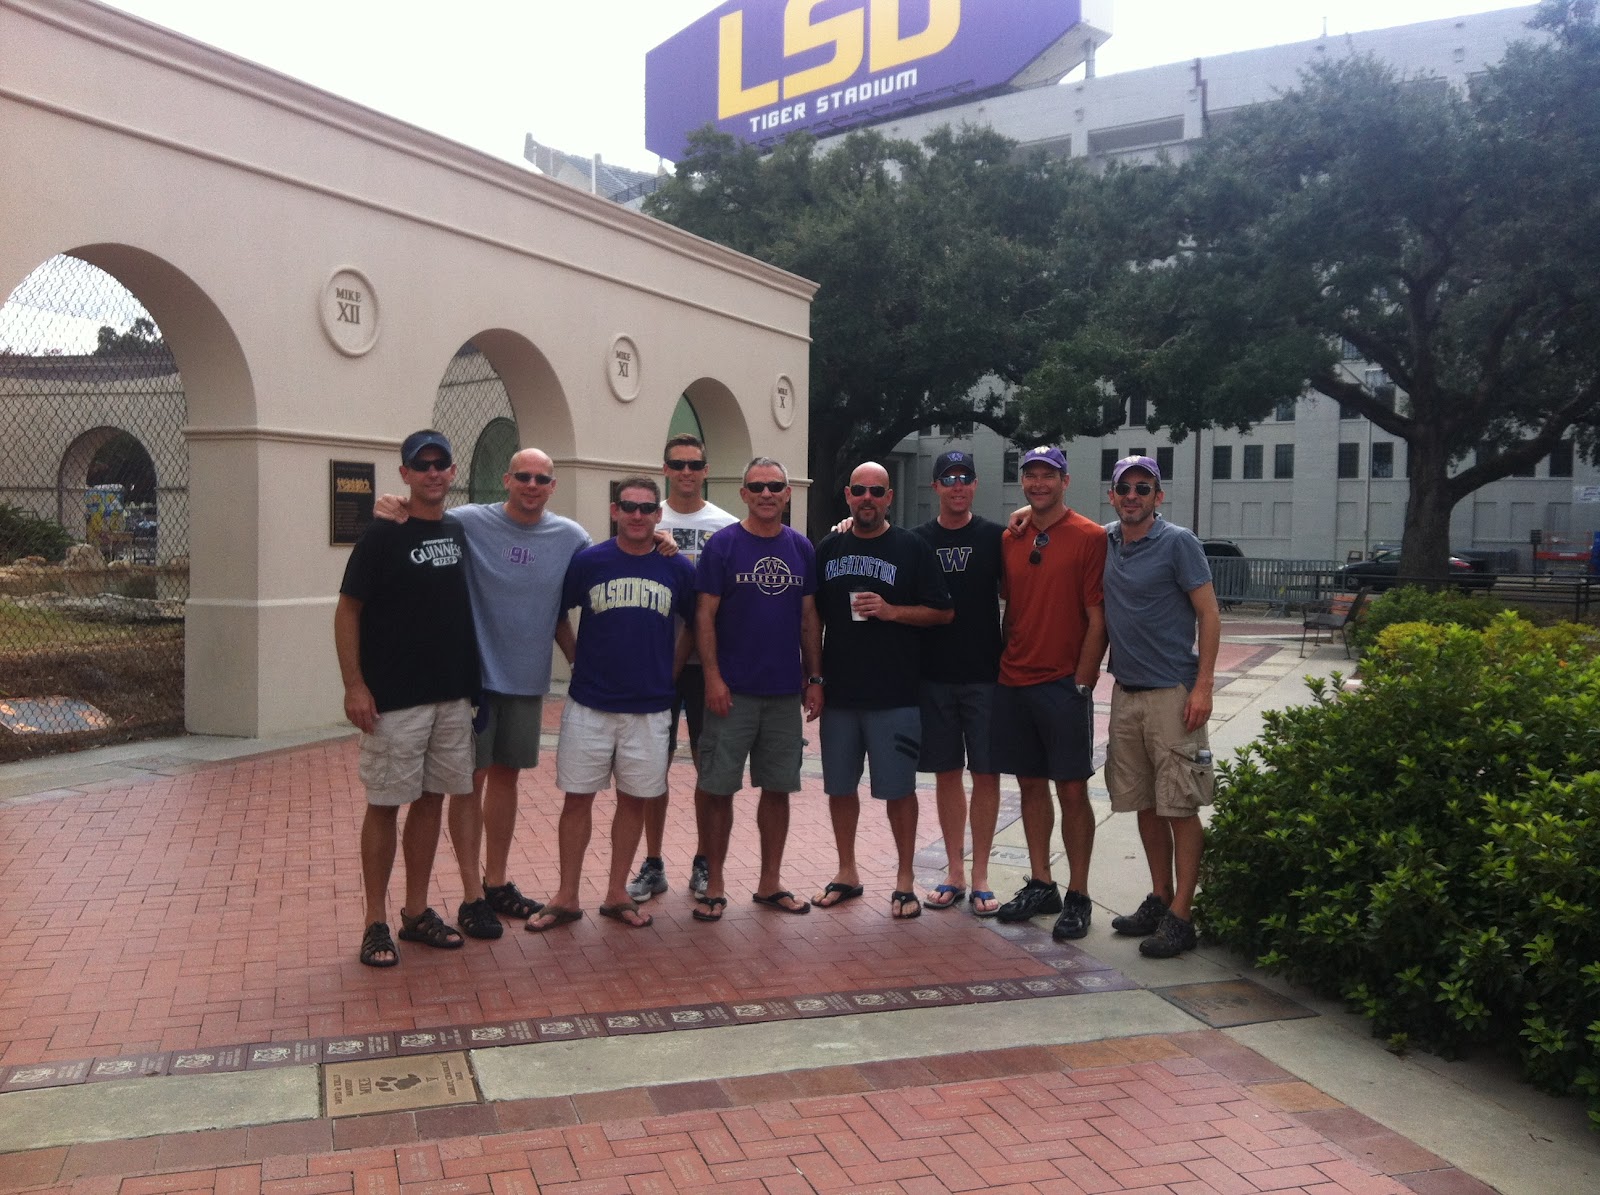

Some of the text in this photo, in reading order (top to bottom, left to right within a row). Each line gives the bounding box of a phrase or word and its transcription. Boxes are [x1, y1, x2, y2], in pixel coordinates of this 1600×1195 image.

[718, 0, 962, 120] LSU
[750, 68, 918, 133] TIGER STADIUM
[336, 287, 361, 303] MIKE
[337, 301, 361, 325] XII
[615, 350, 631, 362] MIKE
[618, 361, 629, 377] XI
[779, 396, 786, 408] X
[410, 543, 463, 564] GUINNESS
[937, 547, 972, 572] W
[760, 559, 781, 575] W
[825, 555, 897, 586] WASHINGTON
[589, 577, 672, 617] WASHINGTON
